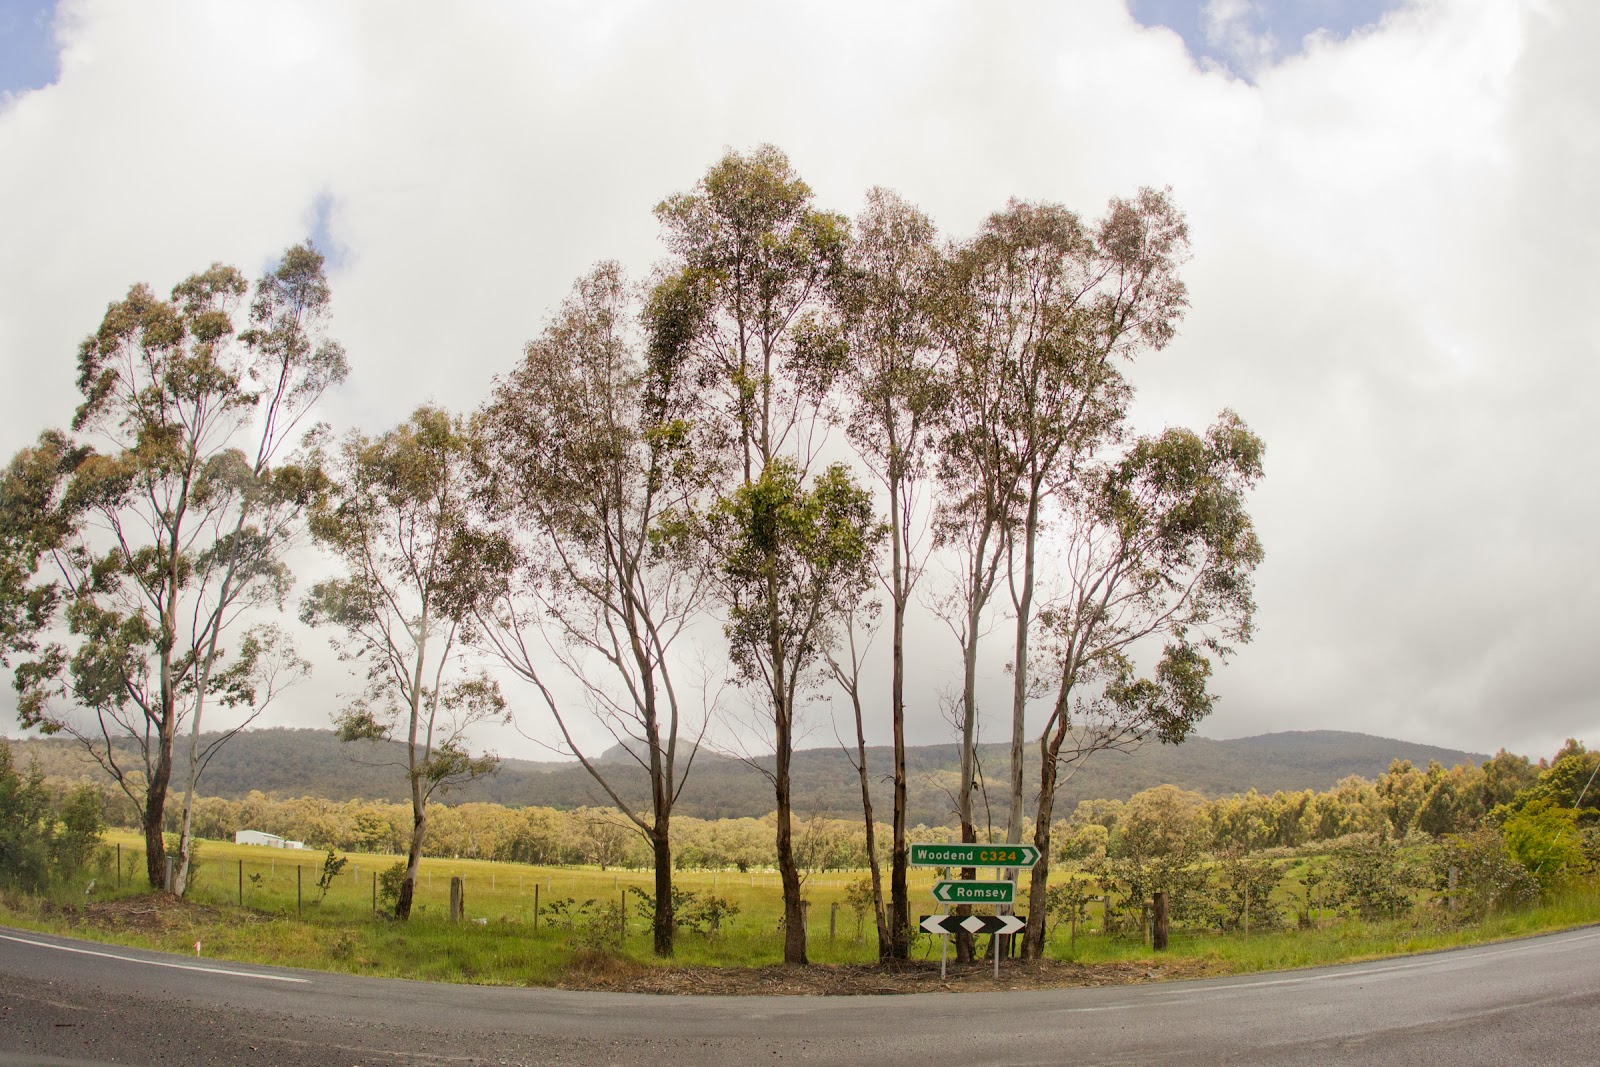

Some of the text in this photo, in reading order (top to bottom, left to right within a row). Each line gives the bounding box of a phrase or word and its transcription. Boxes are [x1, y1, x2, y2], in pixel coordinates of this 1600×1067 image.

[917, 849, 1017, 862] Woodend C324
[956, 887, 1007, 899] Romsey
